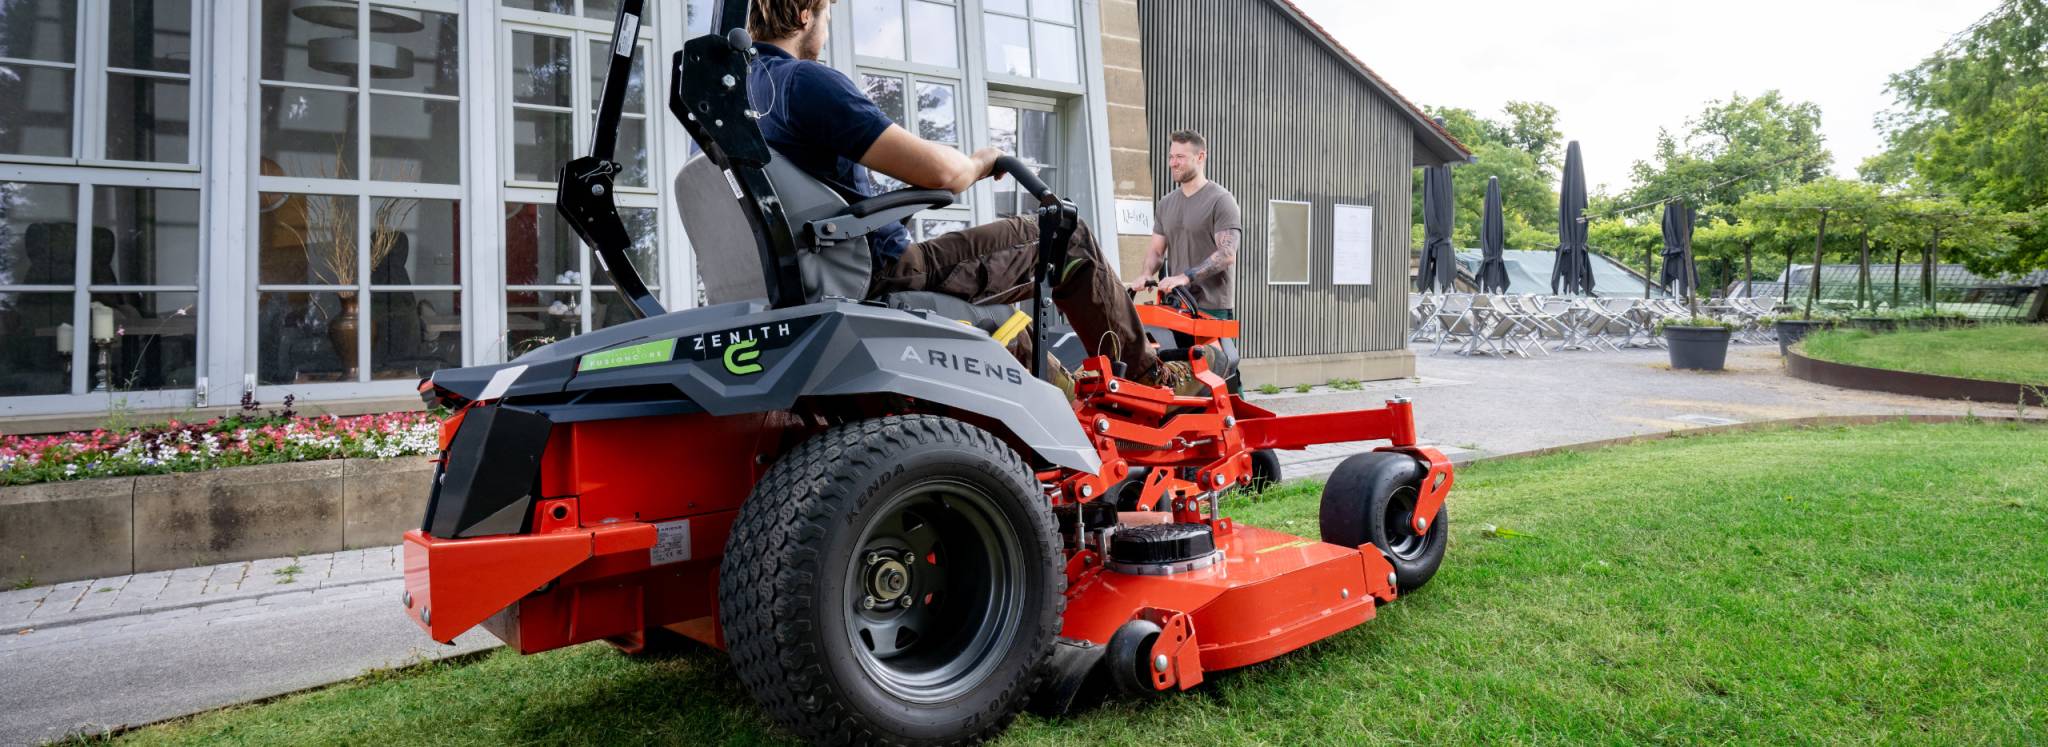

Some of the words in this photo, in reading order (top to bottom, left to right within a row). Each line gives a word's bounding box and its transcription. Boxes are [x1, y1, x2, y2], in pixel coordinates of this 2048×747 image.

[693, 323, 790, 351] ZENITH
[900, 345, 1023, 385] ARIENS
[847, 463, 905, 524] KENDA
